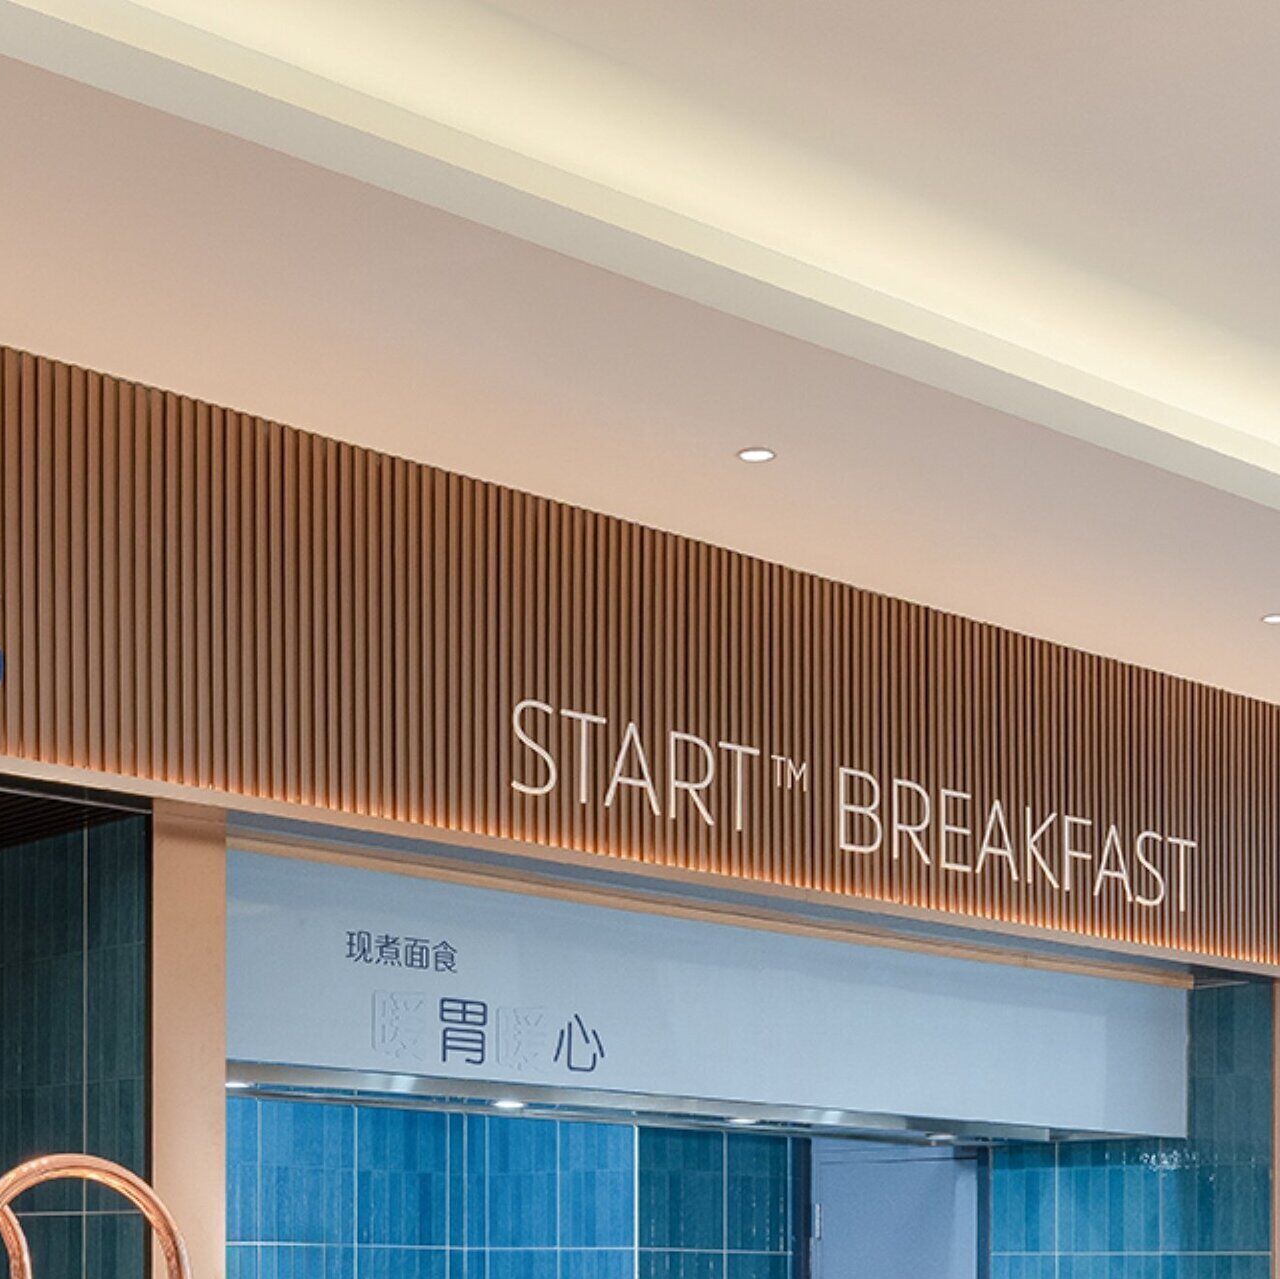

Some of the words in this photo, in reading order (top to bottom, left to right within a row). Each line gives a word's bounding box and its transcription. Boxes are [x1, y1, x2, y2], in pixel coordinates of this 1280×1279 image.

[838, 766, 1198, 912] BREAKFAST
[345, 930, 458, 974] 现煮面食
